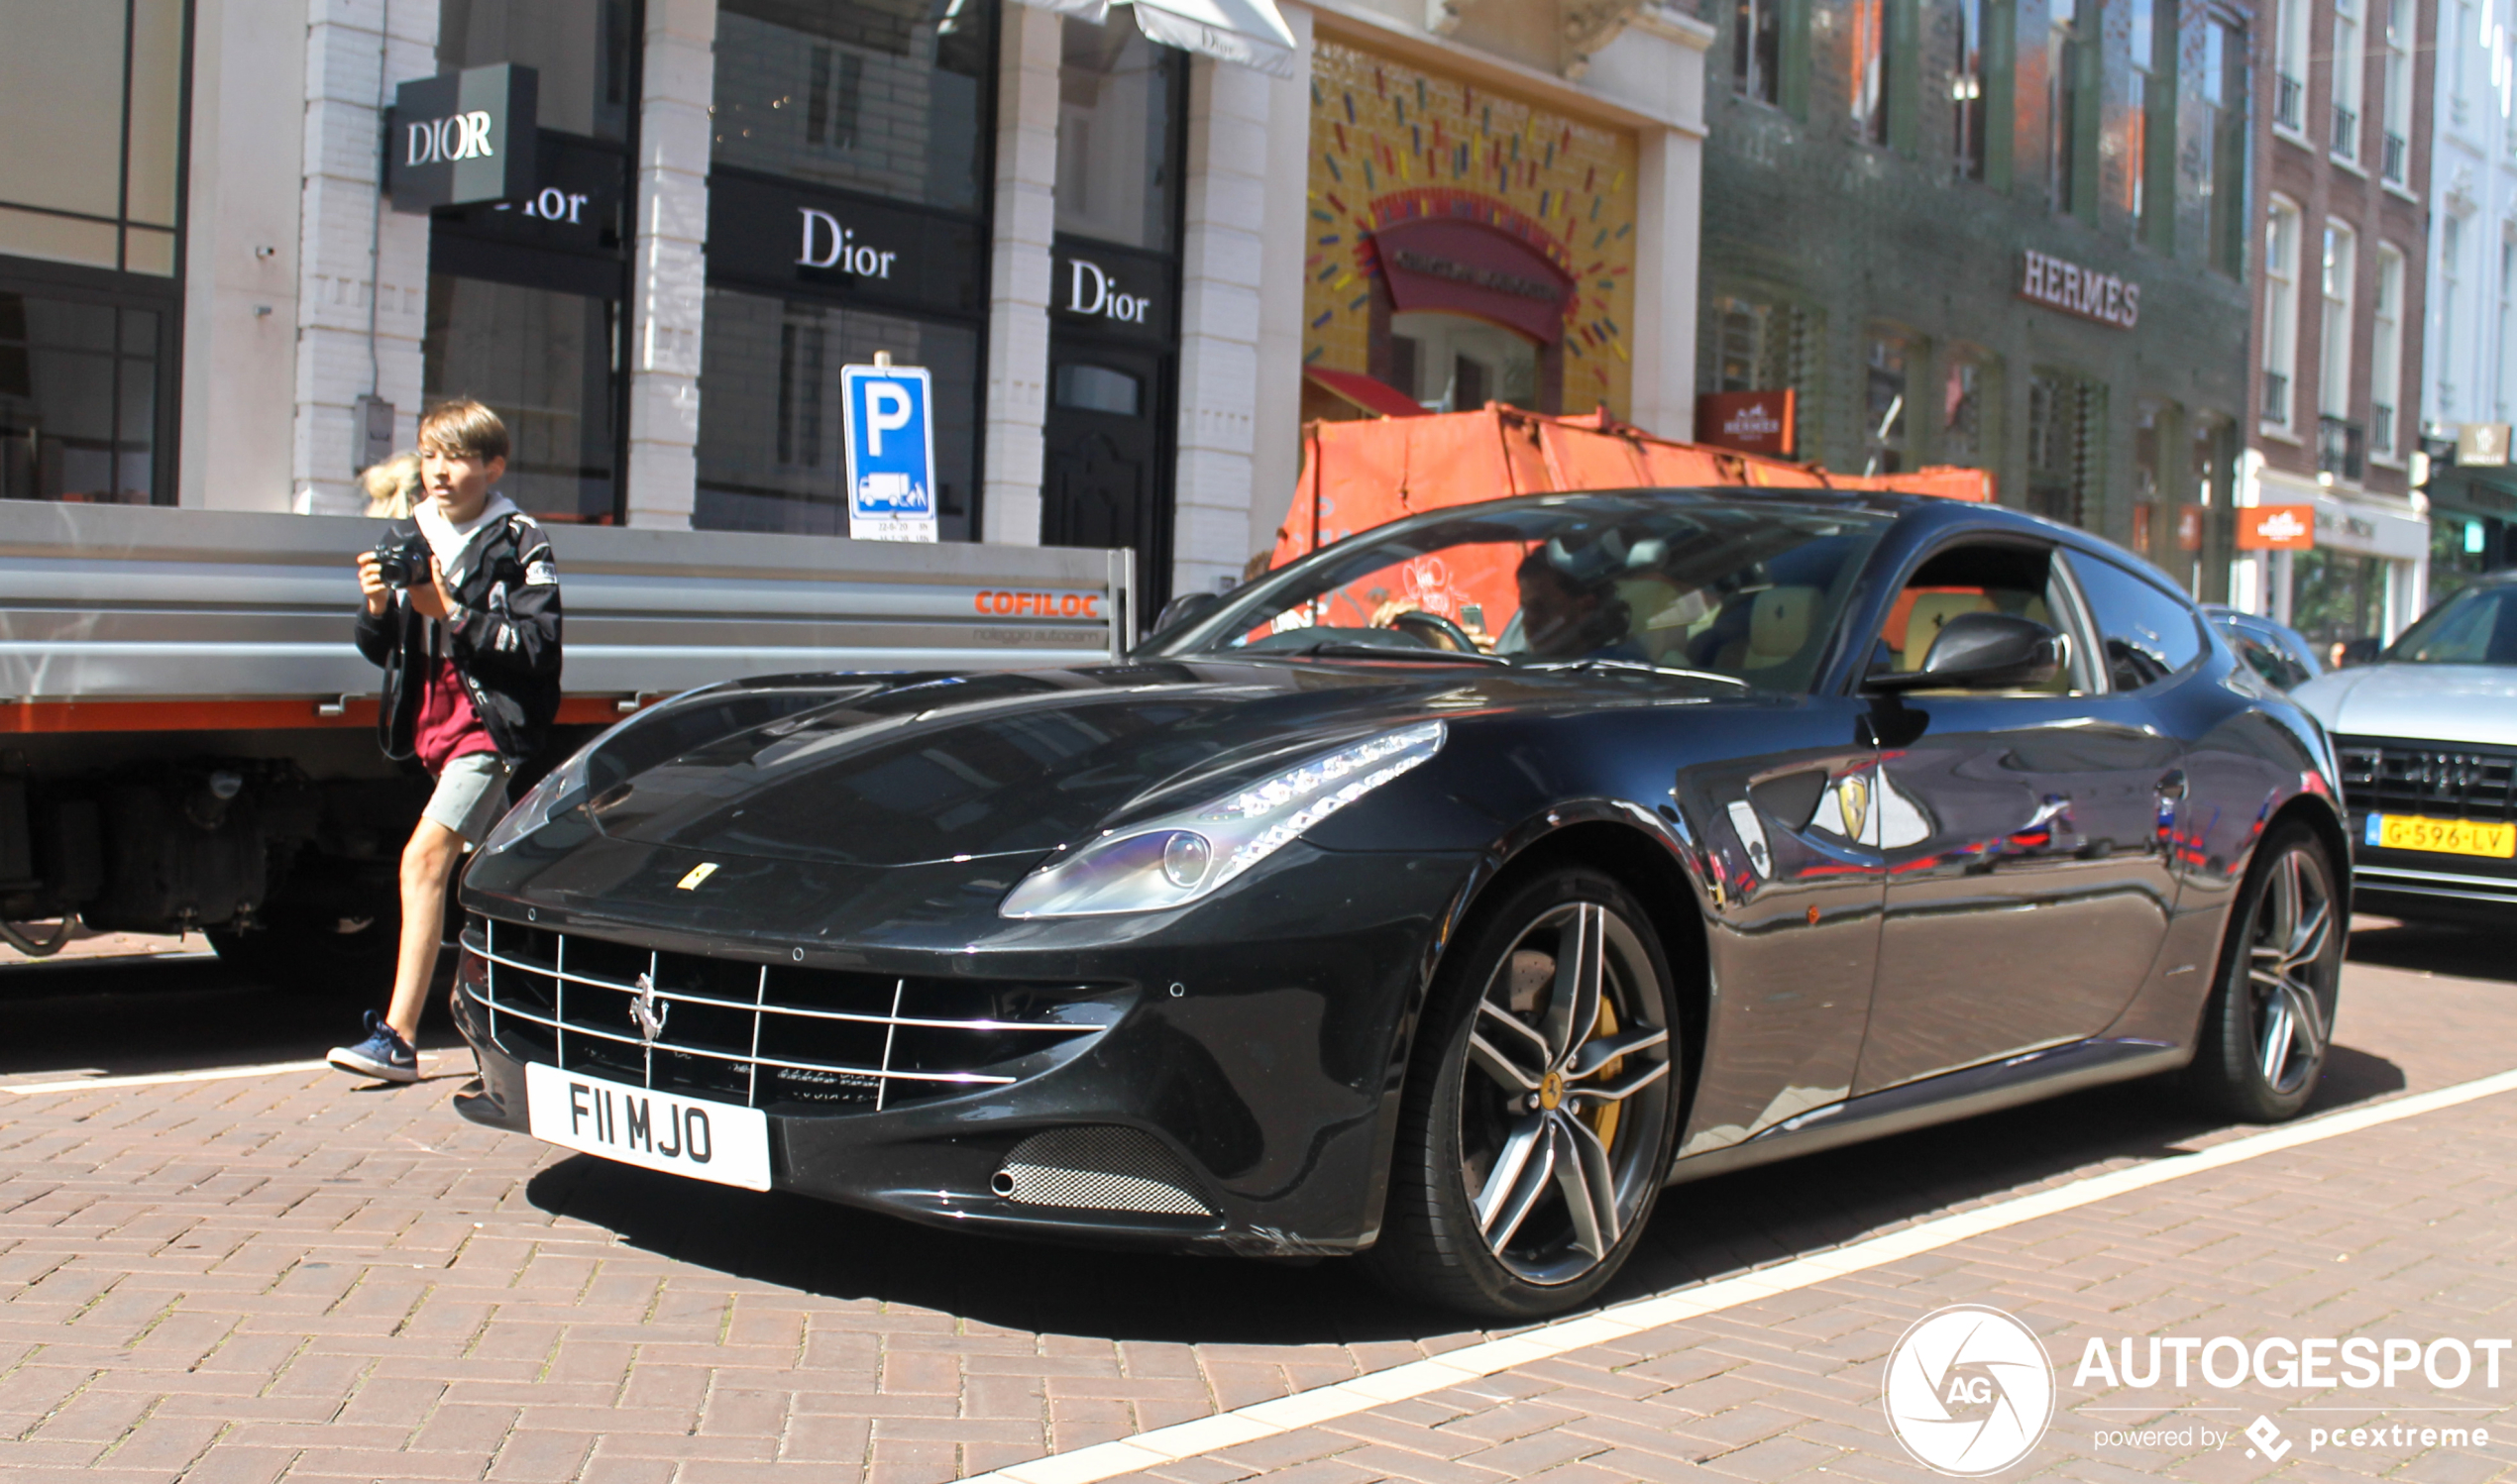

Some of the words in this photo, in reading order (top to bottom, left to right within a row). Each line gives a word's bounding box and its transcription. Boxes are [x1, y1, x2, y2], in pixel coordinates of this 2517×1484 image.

[405, 110, 493, 167] DIOR
[794, 206, 897, 278] Dior
[1065, 258, 1150, 323] Dior
[865, 380, 913, 457] P
[974, 590, 1099, 618] COFILOC
